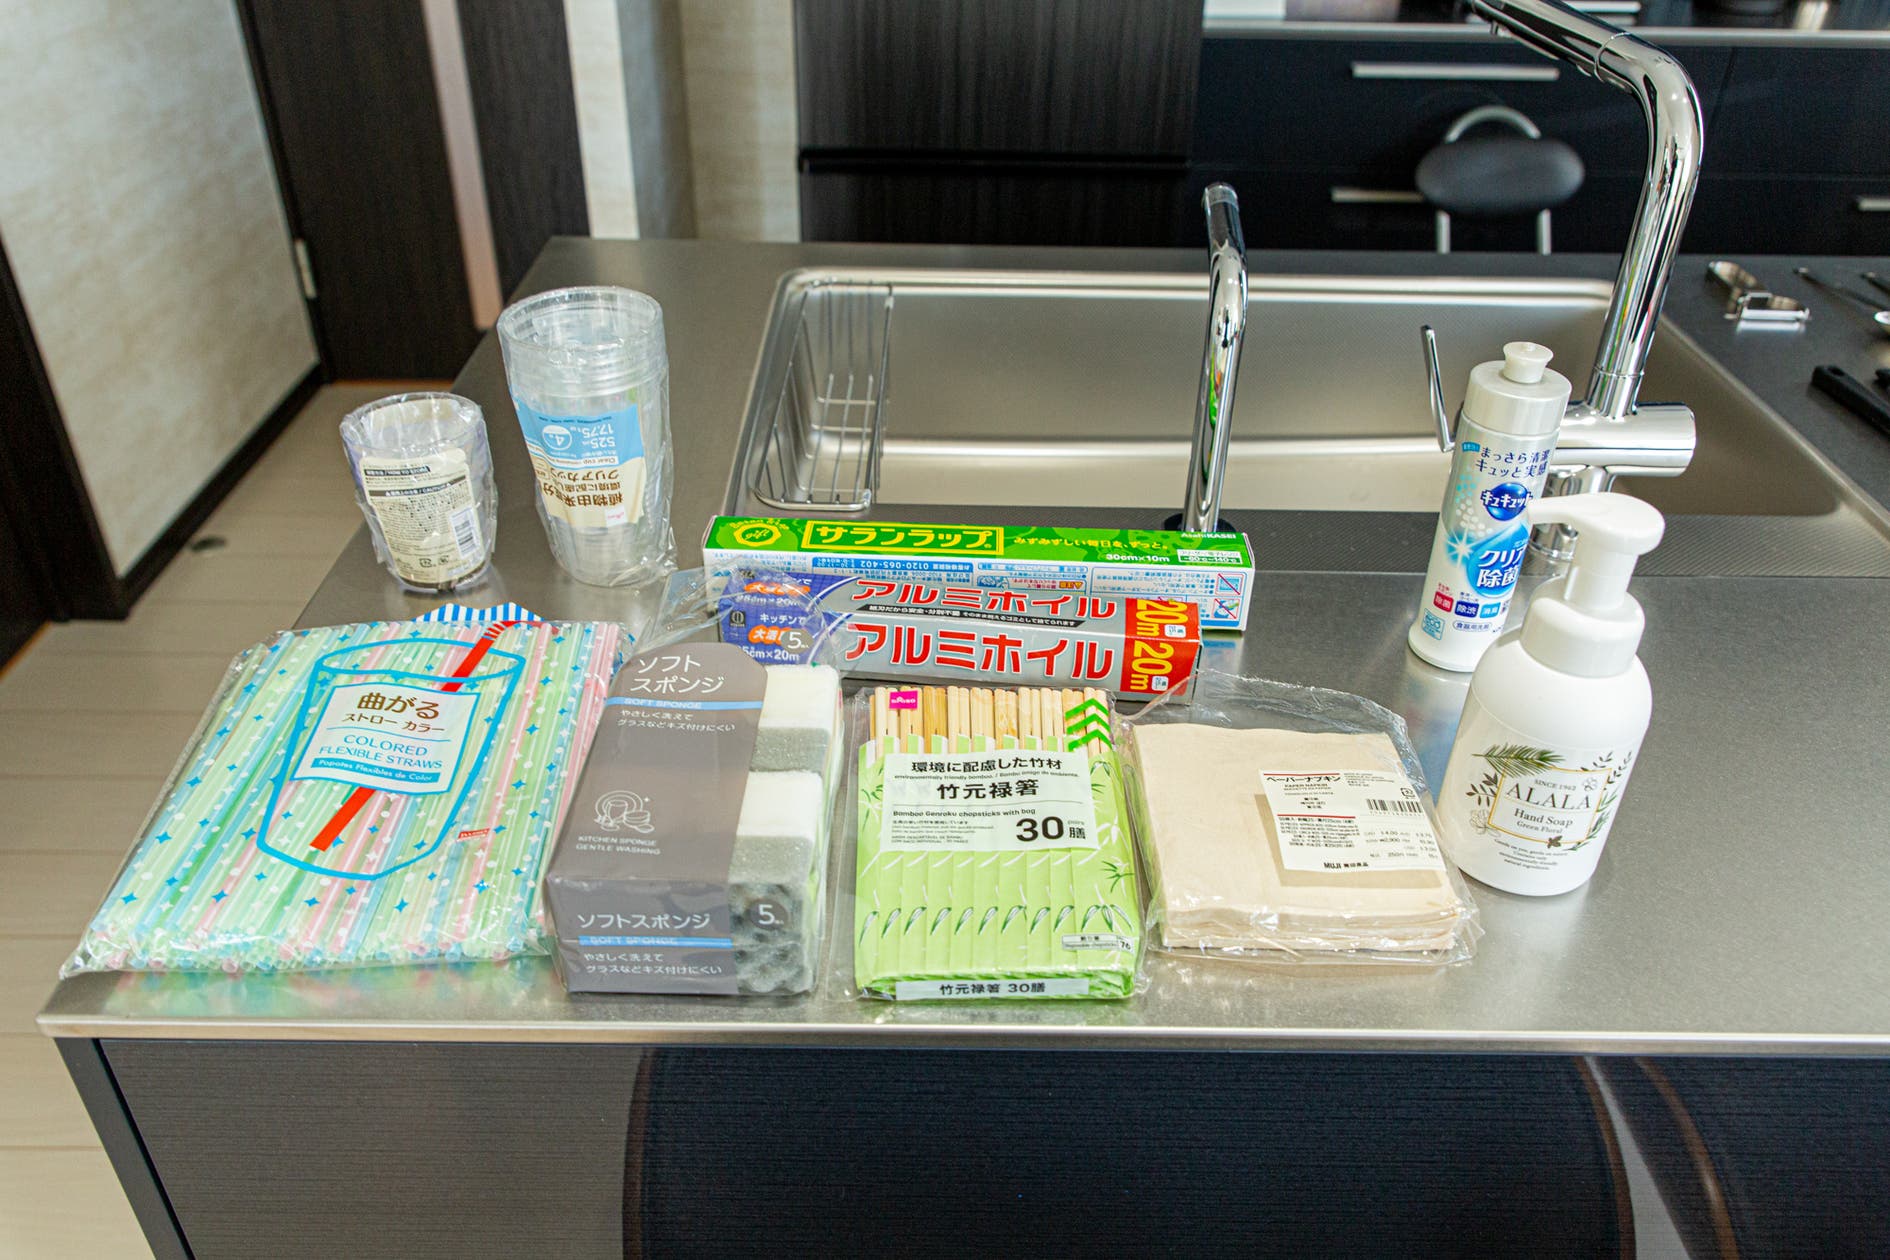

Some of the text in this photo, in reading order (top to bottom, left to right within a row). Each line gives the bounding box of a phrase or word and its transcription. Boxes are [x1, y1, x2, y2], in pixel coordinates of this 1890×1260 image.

[816, 526, 993, 549] サランラップ
[852, 580, 1117, 619] アルミホイル
[1136, 600, 1189, 637] 20m
[845, 622, 1115, 680] アルミホイル
[637, 655, 701, 674] ソフト
[1129, 640, 1175, 691] 20m
[630, 676, 725, 694] スポンジ
[357, 692, 440, 720] 曲がる
[341, 713, 445, 733] ストロー カラー
[343, 734, 428, 757] COLORED
[319, 745, 443, 769] FLEXIBLE STRAWS
[911, 757, 1063, 773] 環境に配慮した竹材
[408, 773, 433, 782] Color
[937, 778, 1039, 800] 竹元禄箸
[1506, 782, 1592, 810] ALALA
[925, 810, 957, 818] Genroku
[958, 810, 1002, 818] chopsticks
[1002, 809, 1020, 817] with
[1514, 808, 1574, 830] Hand Soap
[1016, 815, 1064, 842] 30
[1069, 827, 1086, 840] 膳
[1517, 820, 1539, 831] Green
[576, 843, 612, 852] GENTLE
[577, 913, 711, 930] ソフトスポンジ
[584, 953, 665, 963] やさしく洗えて
[940, 983, 1001, 995] 竹元禄箸
